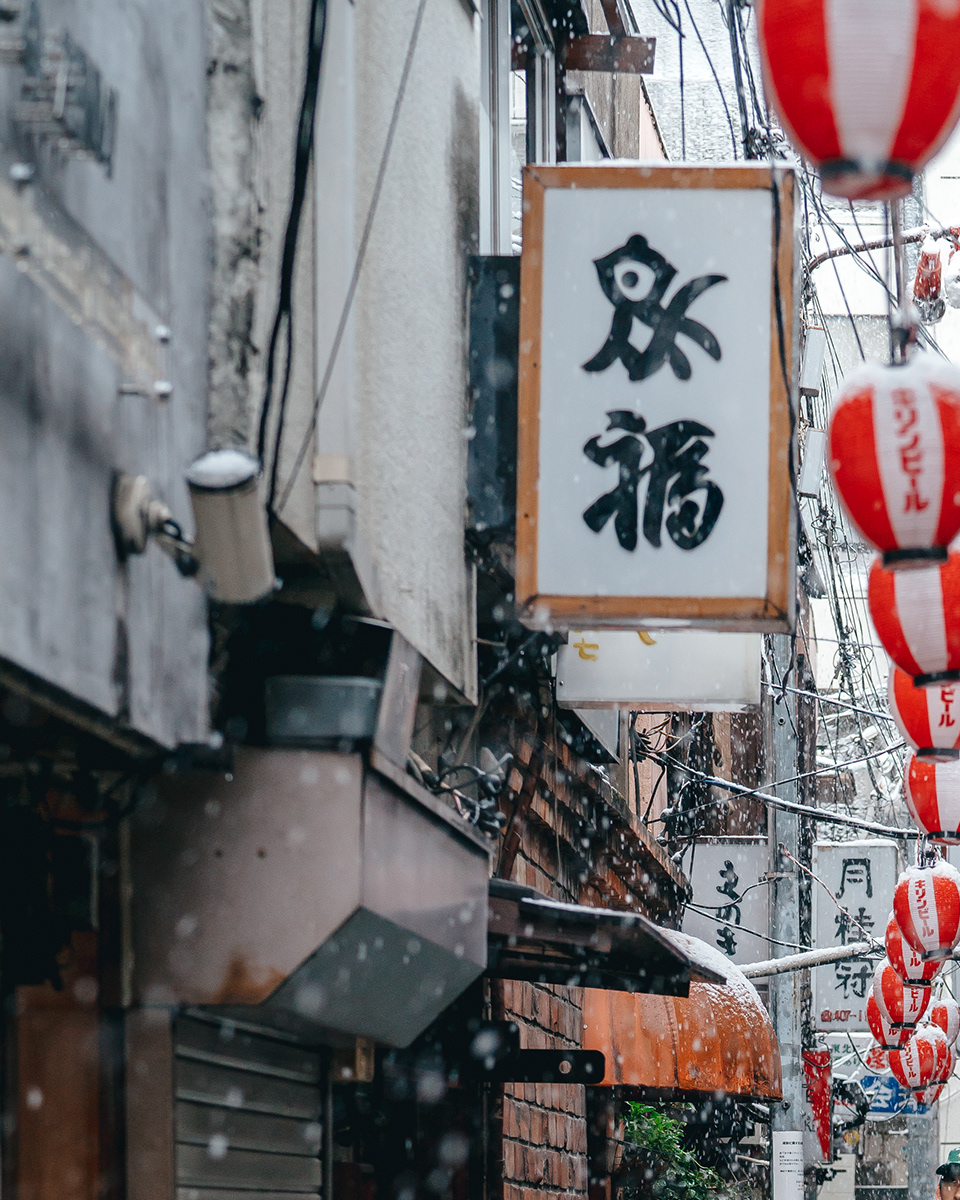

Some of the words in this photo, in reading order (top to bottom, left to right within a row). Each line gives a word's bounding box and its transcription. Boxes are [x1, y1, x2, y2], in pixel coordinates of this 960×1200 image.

[914, 879, 935, 938] キリンビール
[832, 1009, 868, 1022] 407-1
